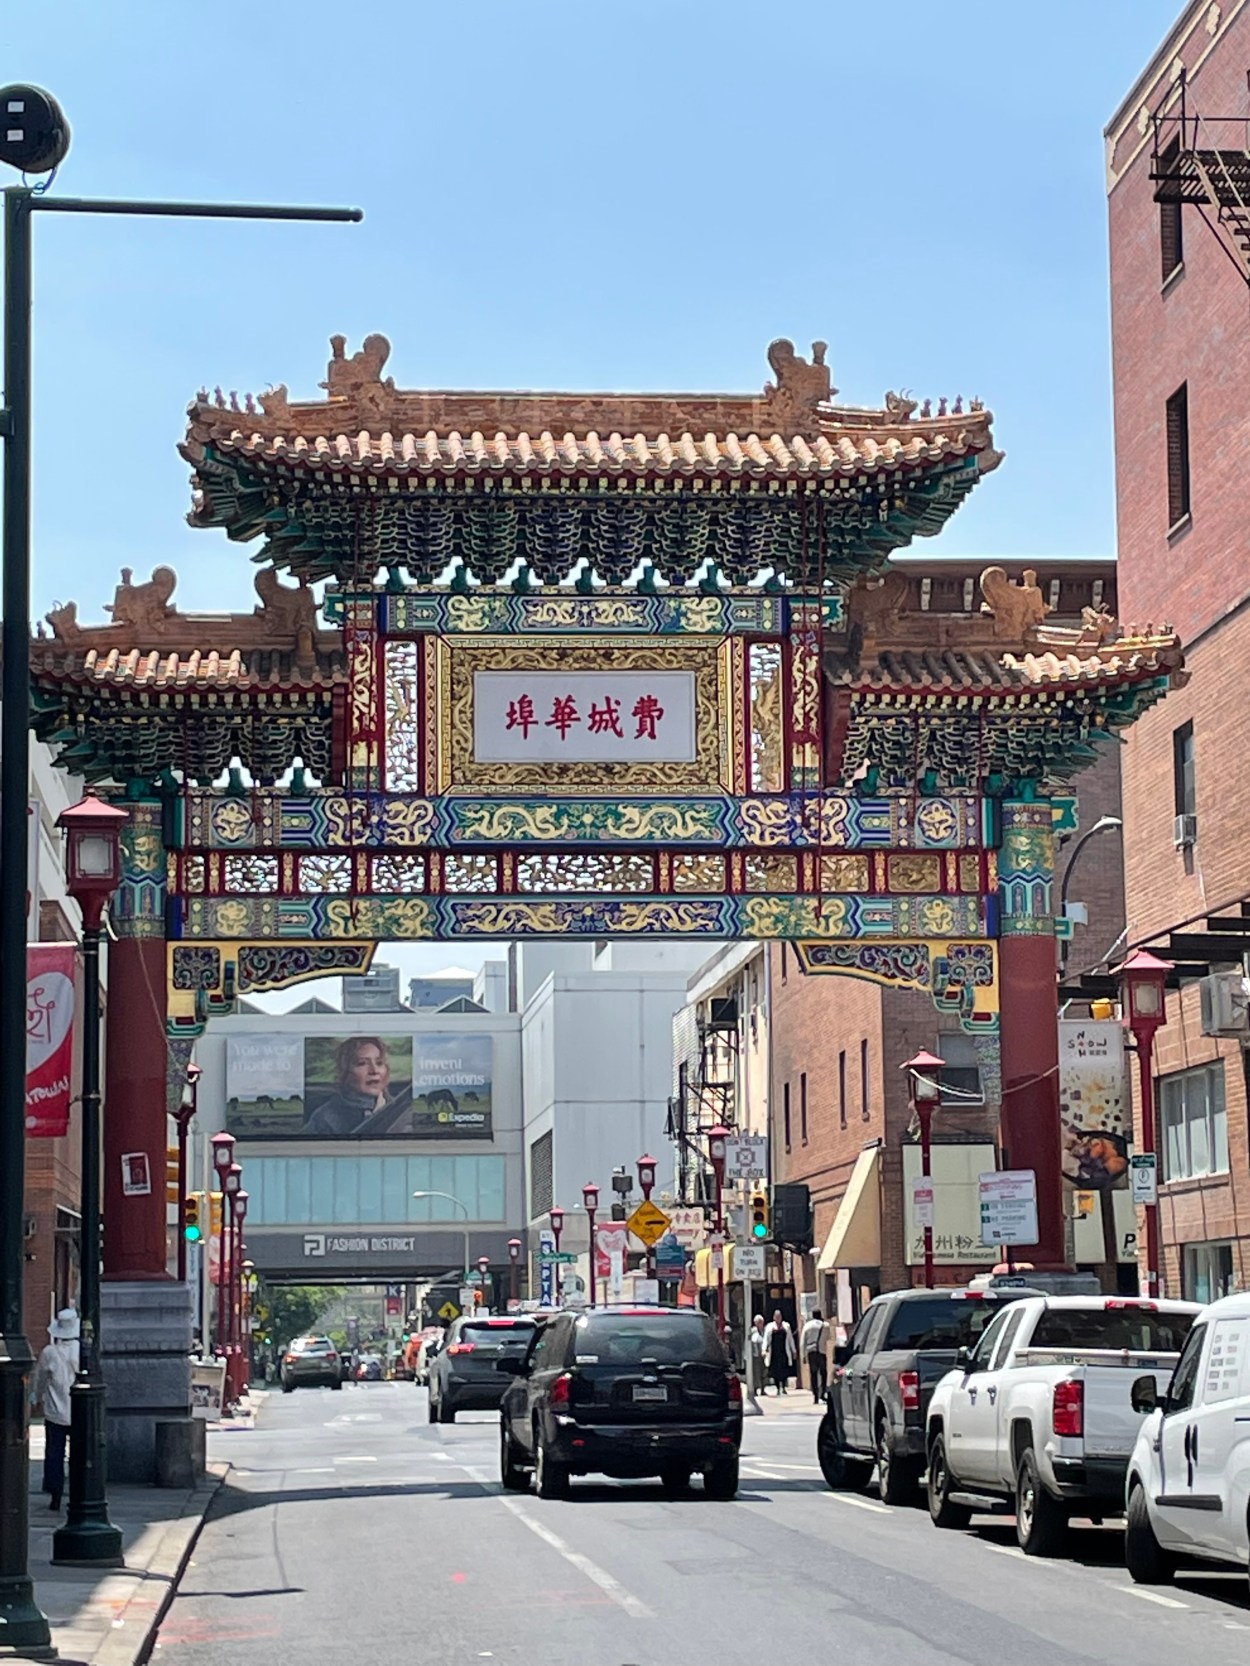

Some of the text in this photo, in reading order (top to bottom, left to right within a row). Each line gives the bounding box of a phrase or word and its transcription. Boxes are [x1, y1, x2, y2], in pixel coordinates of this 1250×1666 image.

[420, 1055, 463, 1070] invent
[419, 1071, 485, 1086] emotions
[448, 1111, 485, 1123] Expedia
[326, 1237, 416, 1252] FASHION DISTRICT
[742, 1249, 755, 1258] NO
[739, 1258, 758, 1267] TURN
[541, 1243, 552, 1306] SPTA
